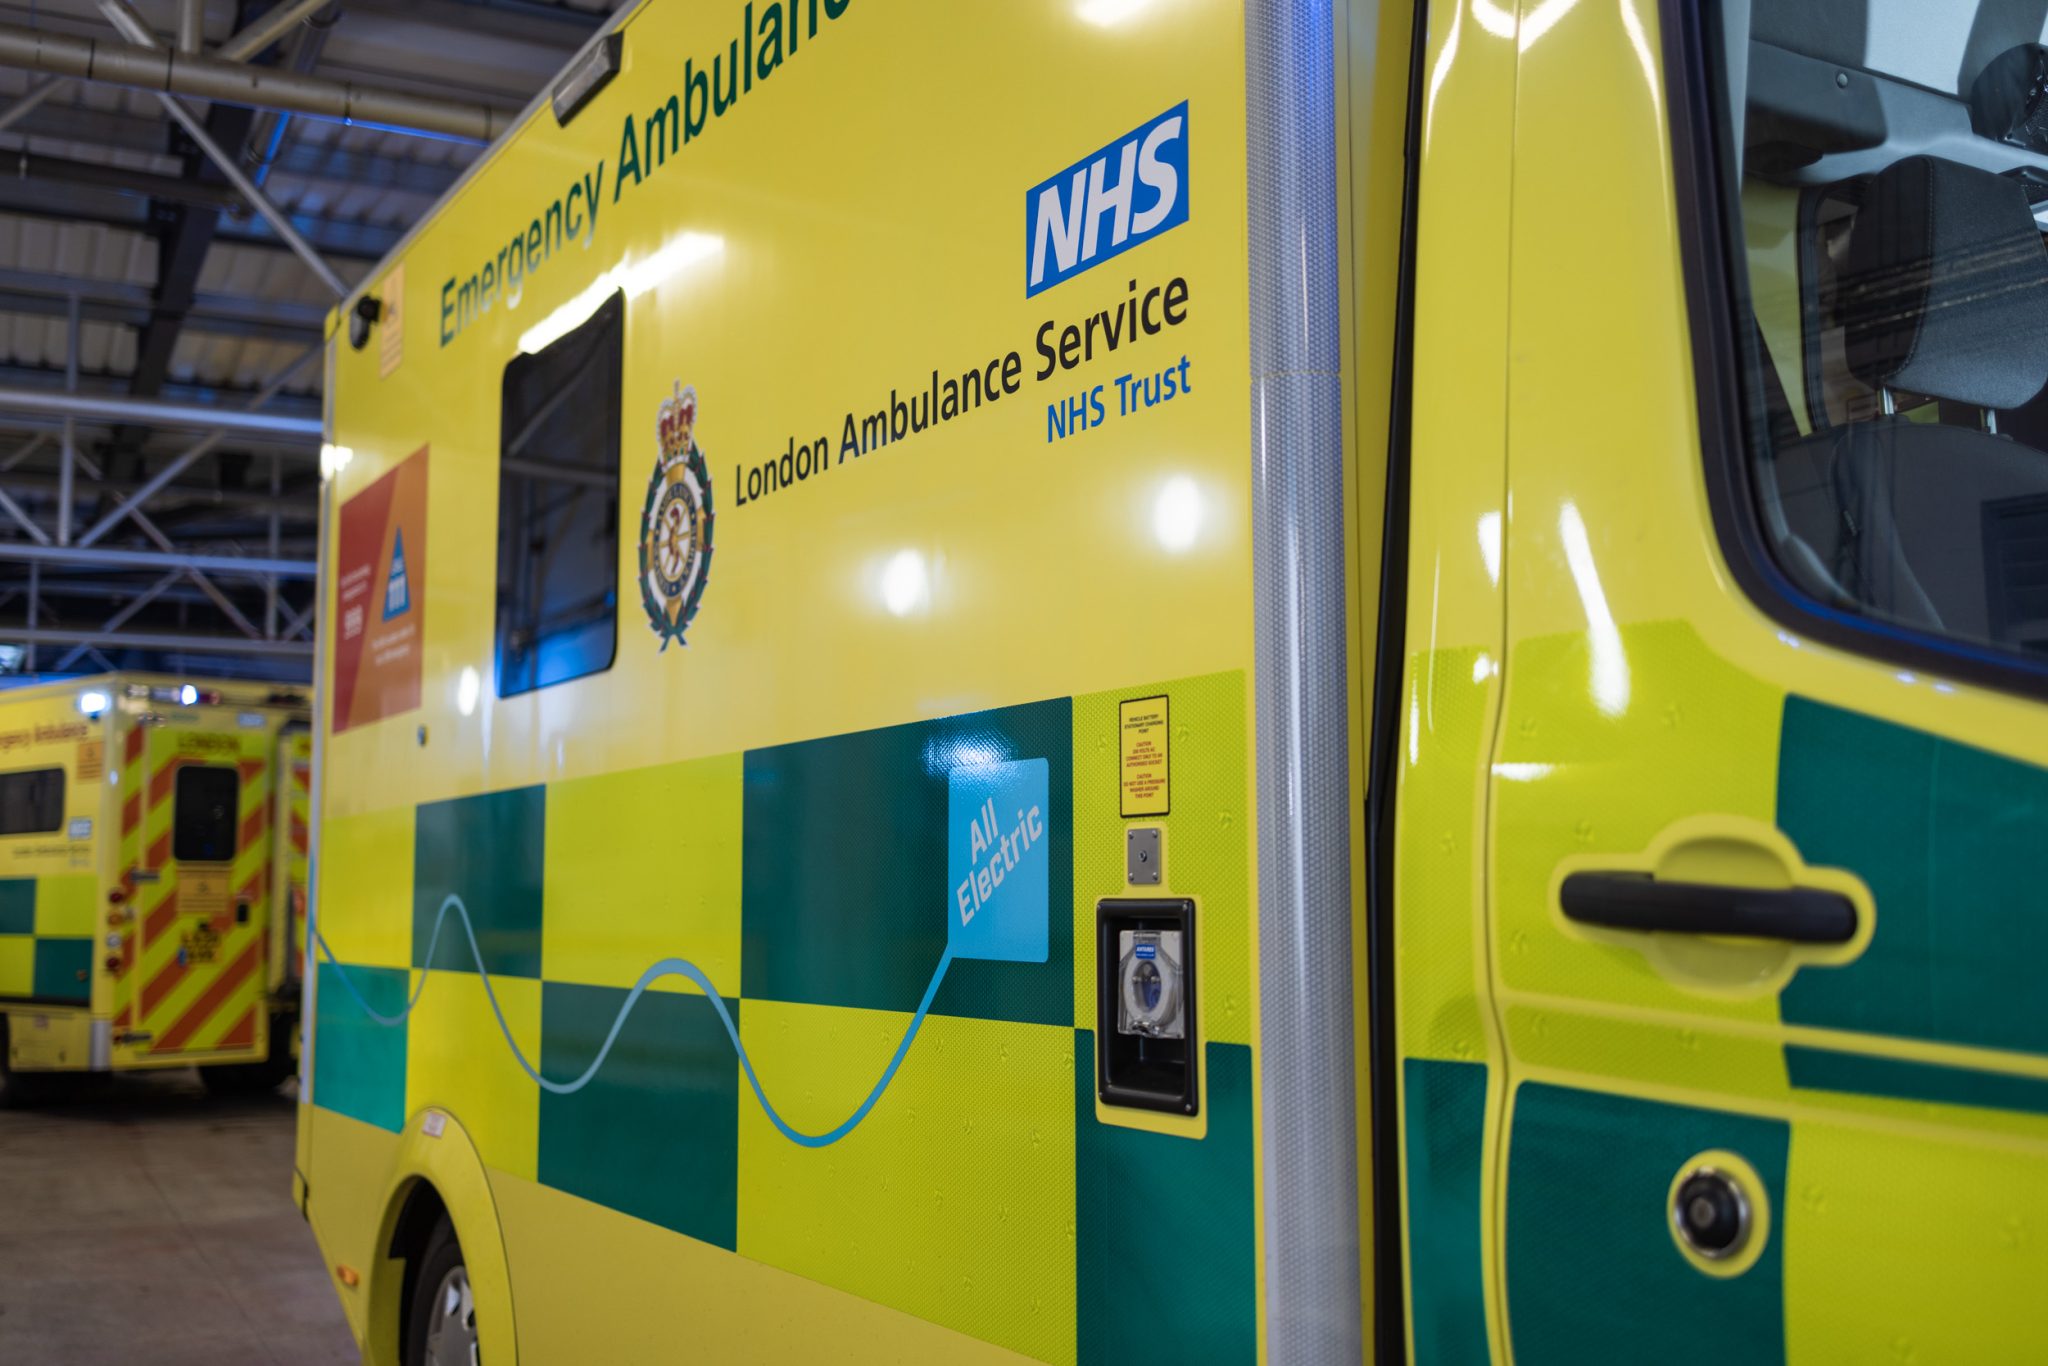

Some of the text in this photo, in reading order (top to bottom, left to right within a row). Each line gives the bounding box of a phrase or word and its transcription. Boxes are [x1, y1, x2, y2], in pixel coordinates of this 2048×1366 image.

[440, 160, 604, 348] Emergency
[614, 0, 850, 204] Ambulan
[1029, 116, 1182, 287] NHS
[735, 276, 1189, 506] London Ambulance Service
[1047, 354, 1191, 443] NHS Trust
[956, 804, 1043, 927] Electric
[970, 797, 998, 865] All
